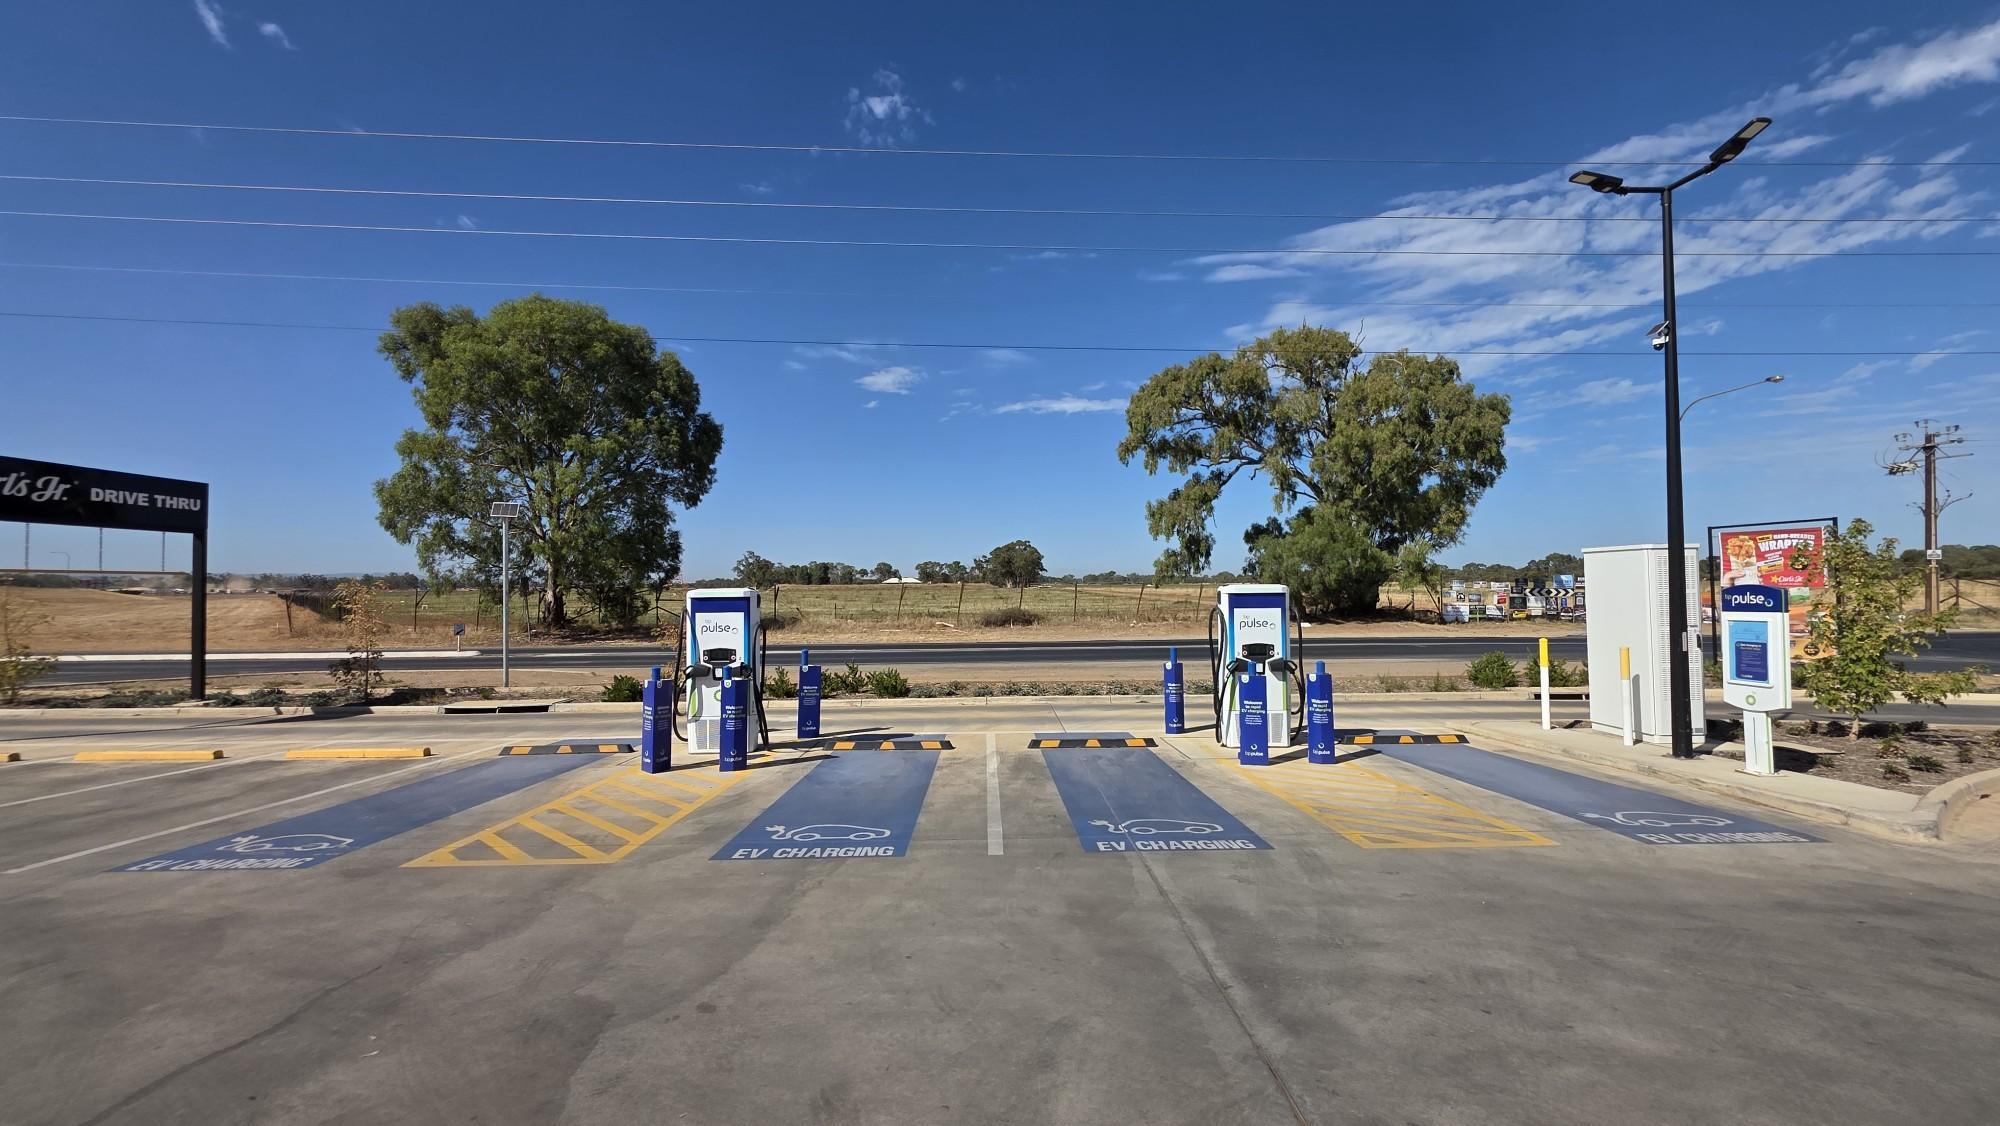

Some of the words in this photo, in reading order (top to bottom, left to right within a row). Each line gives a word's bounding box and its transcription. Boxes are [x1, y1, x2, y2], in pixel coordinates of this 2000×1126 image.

[31, 475, 71, 502] Jr.
[90, 487, 149, 506] DRIVE
[153, 494, 201, 511] THRU
[1732, 591, 1765, 607] pulse
[701, 621, 731, 635] pulse
[1239, 617, 1269, 630] pulse
[1635, 833, 1682, 843] EV
[1674, 831, 1811, 843] CHARGING
[1096, 841, 1126, 851] EV
[1135, 839, 1257, 850] CHARGING
[731, 848, 769, 859] EV
[772, 846, 895, 858] CHARGING
[125, 859, 185, 871] EV
[169, 857, 315, 870] CHARGING
